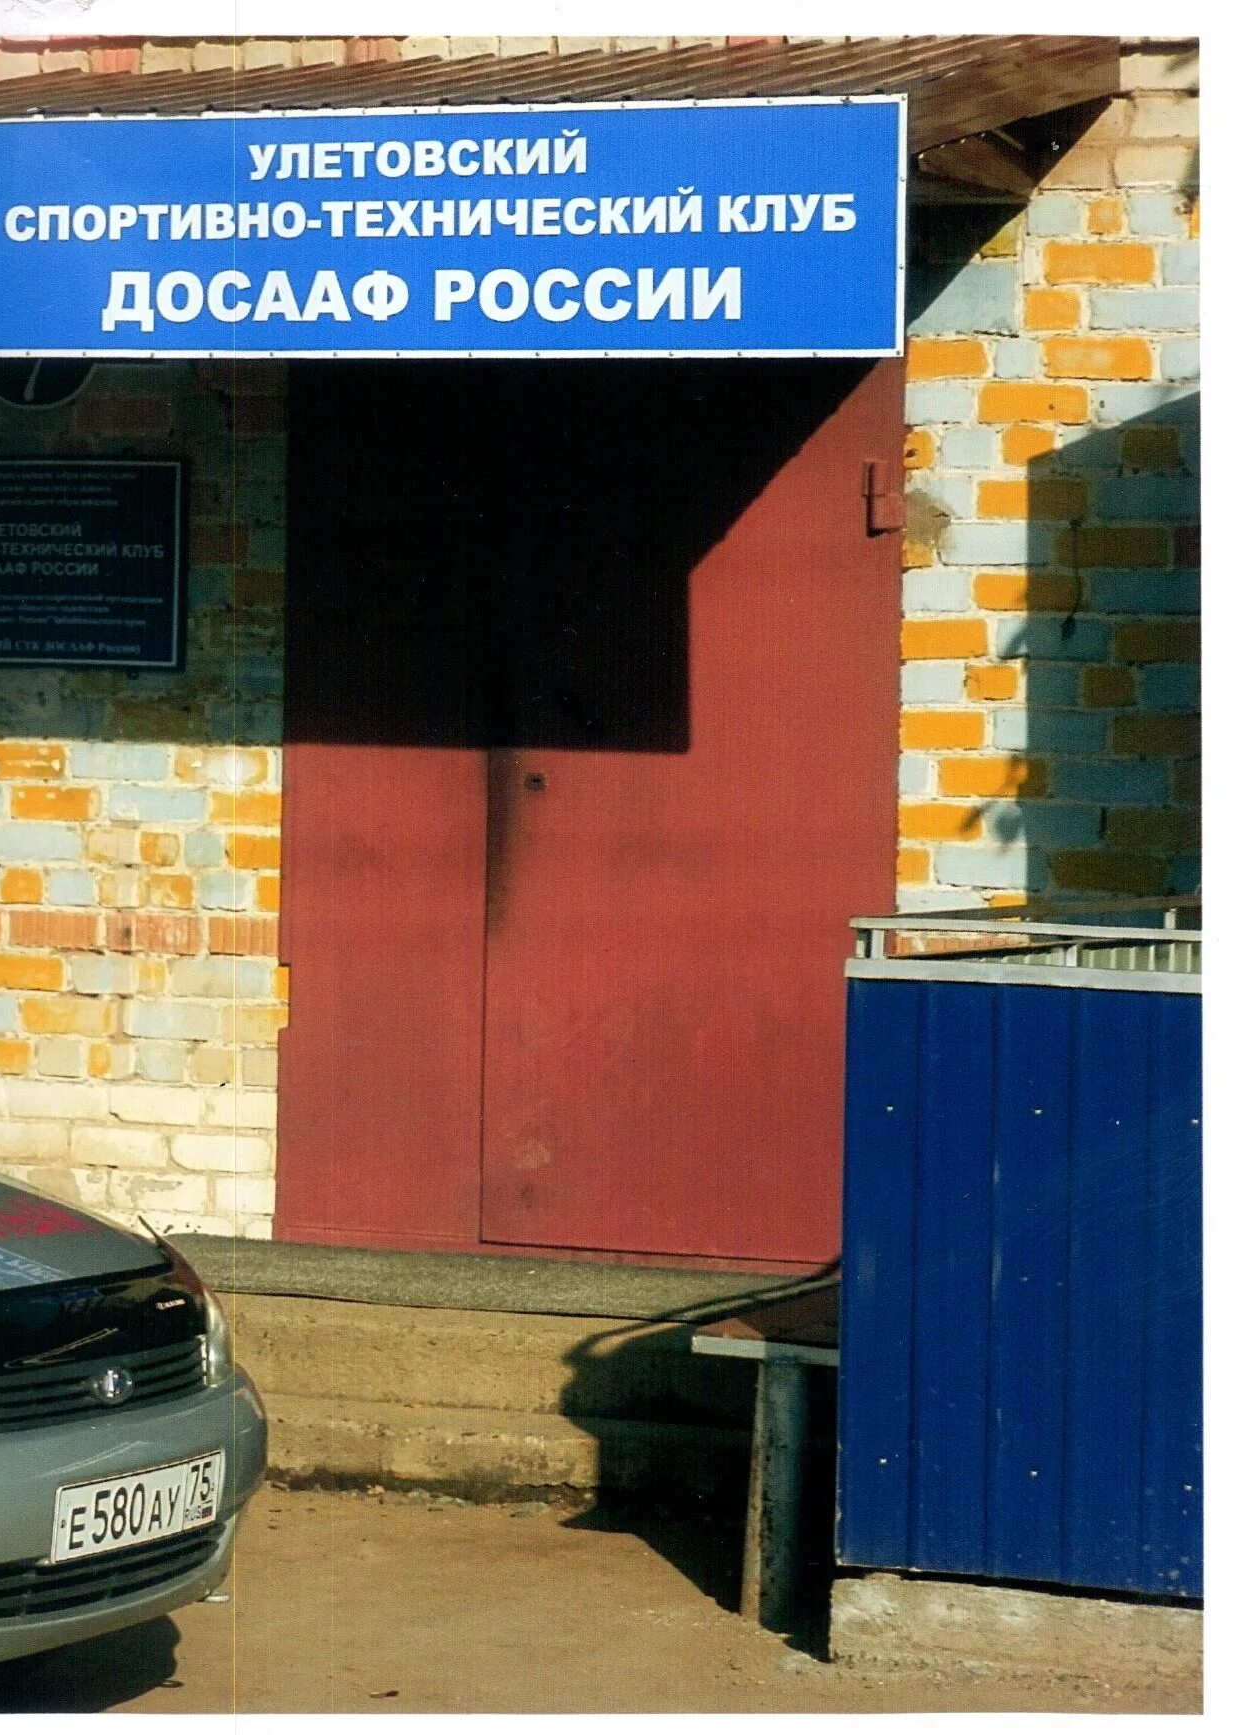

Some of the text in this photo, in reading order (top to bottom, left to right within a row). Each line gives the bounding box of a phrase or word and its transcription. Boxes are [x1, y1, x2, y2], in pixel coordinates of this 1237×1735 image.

[249, 128, 587, 180] УЛЕТОВСКИЙ
[4, 186, 857, 241] СПОРТИВНО-ТЕХНИЧЕСКИЙ КЛУБ
[101, 266, 743, 332] ДОСААФ РОССИИ
[31, 560, 100, 576] РОССИИ
[121, 543, 165, 558] КЛУБ
